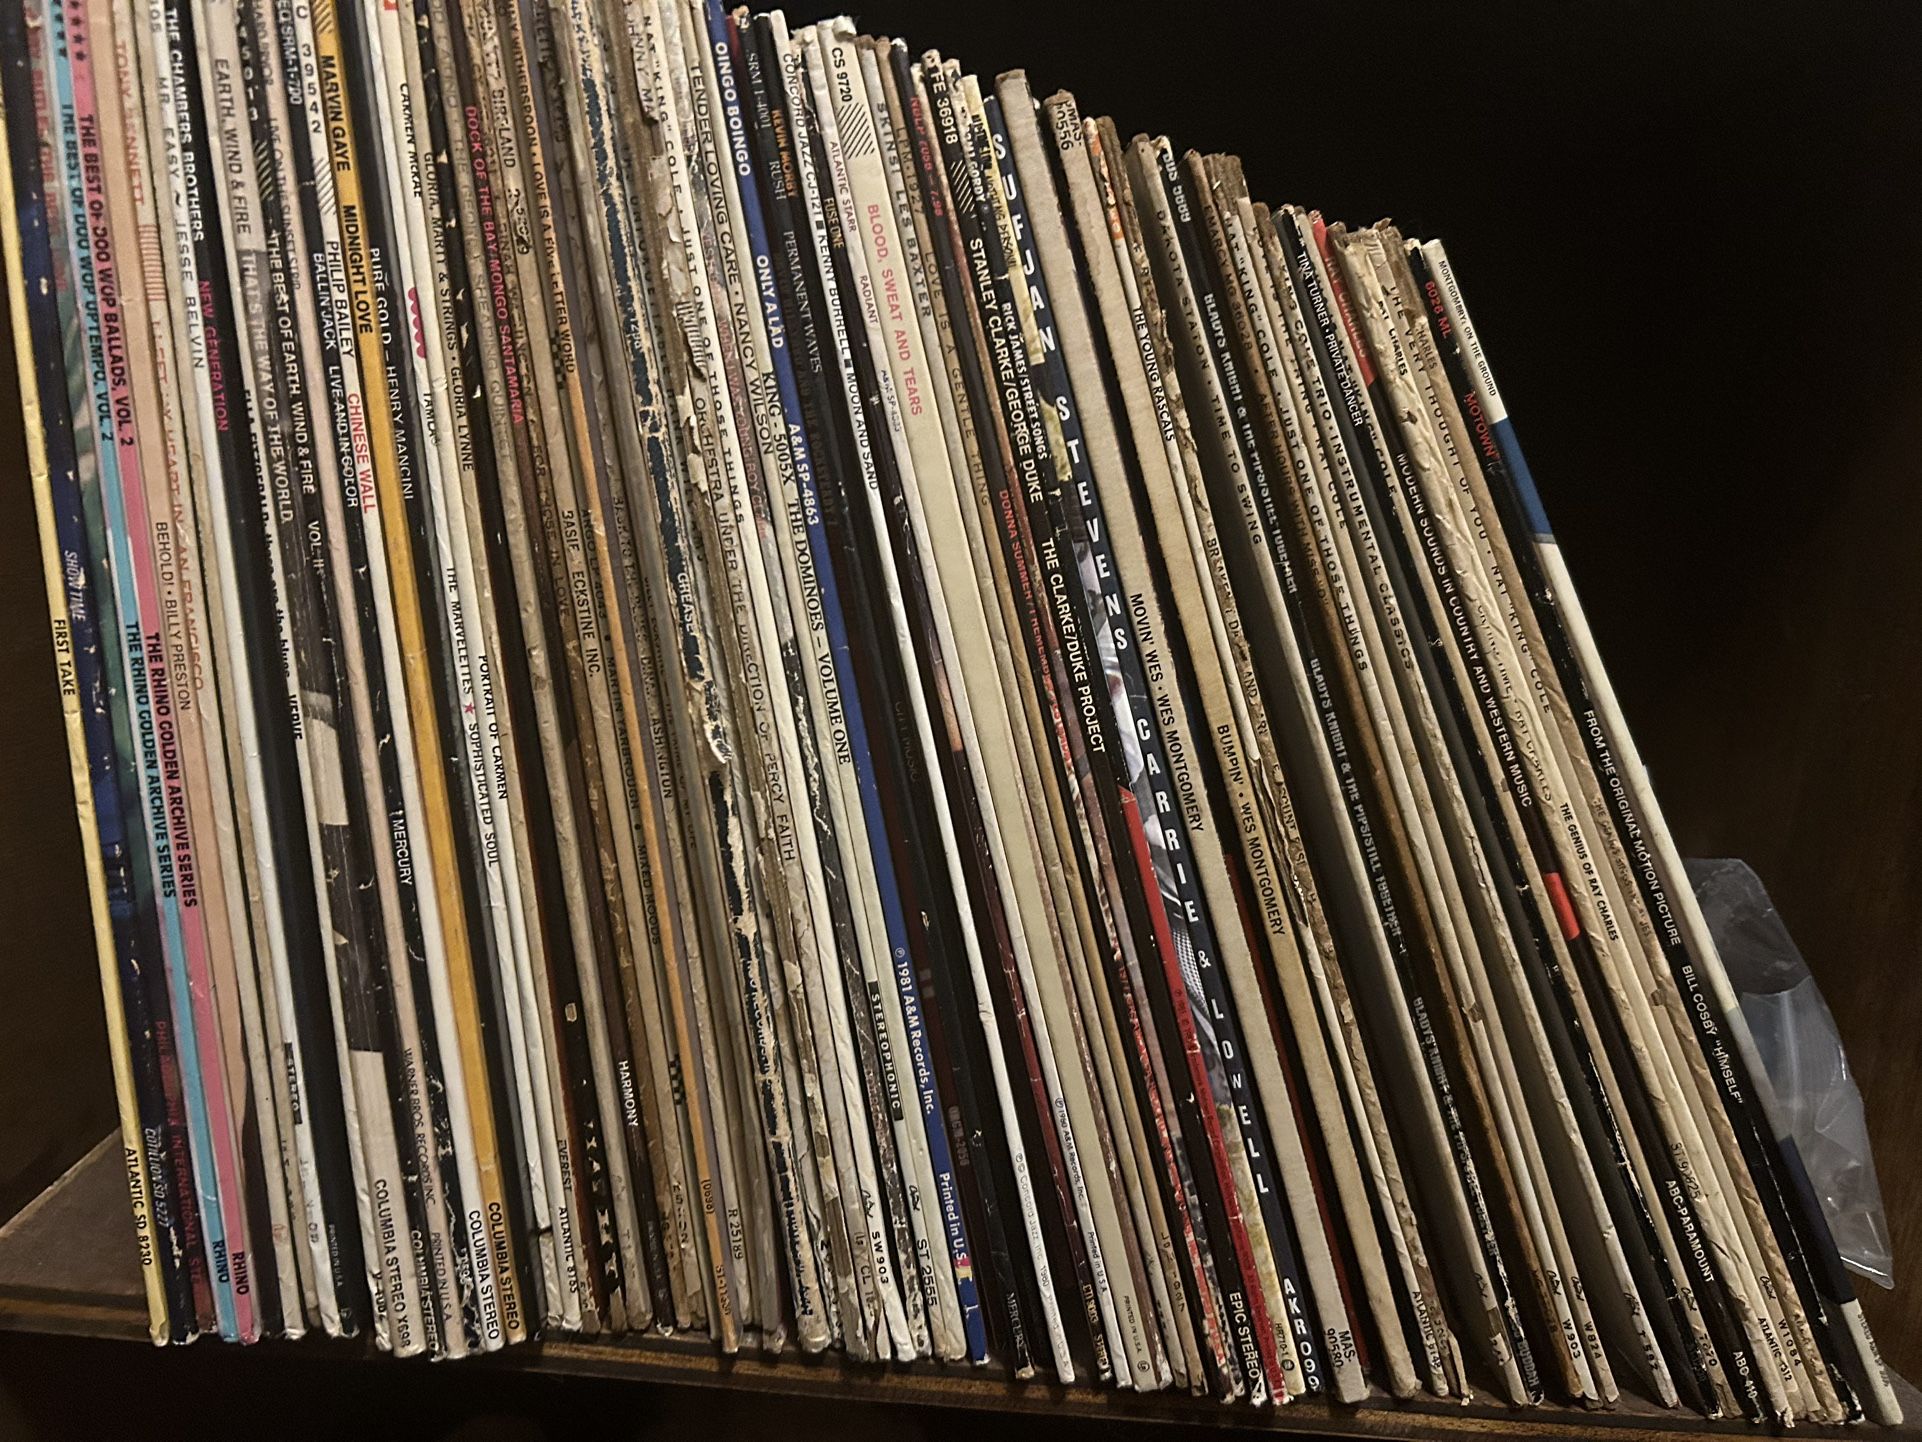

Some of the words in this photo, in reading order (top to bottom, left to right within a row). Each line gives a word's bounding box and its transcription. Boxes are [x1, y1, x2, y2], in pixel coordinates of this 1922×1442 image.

[829, 47, 846, 68] CS
[320, 54, 343, 122] MARVIN
[834, 71, 854, 102] 9720
[928, 72, 947, 93] FE
[77, 113, 97, 148] THE
[464, 106, 483, 153] DOCK
[712, 41, 738, 101] OINGO
[725, 106, 753, 176] BOINGO
[935, 98, 959, 144] 36918
[82, 152, 103, 193] BEST
[330, 127, 350, 171] GAYE
[472, 158, 487, 179] OF
[477, 186, 492, 214] THE
[766, 160, 787, 200] RUSH
[826, 141, 850, 195] ATLANTIC
[840, 197, 858, 232] STARR
[88, 199, 106, 220] OF
[865, 203, 890, 262] BLOOD,
[91, 225, 112, 262] DOO
[325, 240, 345, 293] PHILIP
[688, 62, 715, 144] TENDER
[705, 150, 731, 224] LOVING
[720, 231, 743, 283] CARE
[734, 302, 760, 369] NANCY
[748, 376, 777, 455] WILSON
[988, 133, 1058, 352] SUFJAN
[97, 267, 117, 307] WOP
[341, 205, 365, 285] MIDNIGHT
[354, 290, 372, 333] LOVE
[488, 259, 509, 319] MONGO
[753, 254, 775, 297] ONLY
[763, 302, 778, 313] A
[781, 230, 812, 318] PERMANENT
[801, 321, 824, 373] WAVES
[857, 275, 878, 323] RADIANT
[879, 269, 903, 320] SWEAT
[998, 301, 1017, 330] RICK
[1422, 280, 1445, 314] 6026
[1435, 316, 1455, 338] ML
[333, 298, 354, 358] BAILEY
[1130, 306, 1148, 332] THE
[1294, 251, 1314, 278] TINA
[1304, 279, 1330, 327] TURNER
[1322, 333, 1348, 379] PRIVATE
[1338, 380, 1364, 426] DANCER
[103, 312, 128, 391] BALLADS,
[892, 329, 912, 360] AND
[1137, 333, 1161, 382] YOUNG
[499, 325, 525, 423] SANTAMARIA
[843, 372, 864, 415] MOON
[901, 366, 924, 415] TEARS
[966, 237, 998, 310] STANLEY
[985, 315, 1033, 454] CLARKE/GEORGE
[1020, 460, 1045, 502] DUKE
[1006, 333, 1040, 418] JAMES/STREET
[114, 398, 133, 432] VOL.
[758, 372, 781, 416] KING
[1151, 386, 1177, 441] RASCALS
[119, 435, 135, 446] 2
[345, 393, 368, 463] CHINESE
[785, 423, 806, 460] A&M
[854, 419, 871, 447] AND
[1029, 422, 1050, 460] SONGS
[770, 434, 795, 486] 5005X
[861, 451, 881, 490] SAND
[1394, 453, 1427, 513] MODERN
[356, 468, 375, 513] WALL
[794, 463, 821, 525] SP-4863
[784, 498, 806, 536] THE
[1053, 395, 1130, 649] STEVENS
[153, 521, 176, 586] BEHOLD!
[1039, 537, 1061, 570] THE
[1418, 518, 1449, 575] SOUNDS
[674, 572, 698, 632] GREASE
[792, 539, 825, 631] DOMINOES
[1439, 578, 1456, 593] IN
[53, 618, 69, 653] FIRST
[164, 599, 183, 640] BILLY
[1048, 573, 1089, 682] CLARKE/DUKE
[1127, 593, 1156, 647] MOVIN'
[1446, 597, 1480, 660] COUNTRY
[145, 631, 163, 664] THE
[1142, 649, 1165, 682] WES
[58, 660, 75, 695] TAKE
[150, 667, 171, 716] RHINO
[170, 643, 192, 710] PRESTON
[815, 653, 844, 724] VOLUME
[1471, 665, 1492, 694] AND
[448, 599, 473, 694] MARVELETTES
[466, 722, 493, 824] SOPHISTICATED
[483, 833, 500, 867] SOUL
[1076, 685, 1107, 752] PROJECT
[1155, 694, 1177, 725] WES
[1483, 697, 1517, 761] WESTERN
[157, 720, 179, 779] GOLDEN
[831, 729, 852, 764] ONE
[1215, 724, 1244, 784] BUMPIN'
[1164, 730, 1206, 832] MONTGOMERY
[1507, 764, 1534, 807] MUSIC
[166, 784, 189, 850] ARCHIVE
[1132, 718, 1200, 922] CARRIE
[1236, 803, 1258, 835] WES
[1557, 802, 1575, 821] THE
[1581, 710, 1607, 748] FROM
[1596, 749, 1618, 776] THE
[1607, 778, 1641, 837] ORIGINAL
[1630, 840, 1661, 890] MOTION
[1650, 892, 1682, 945] PICTURE
[1564, 823, 1589, 860] GENIUS
[176, 854, 197, 907] SERIES
[1245, 836, 1286, 935] MONTGOMERY
[1579, 862, 1595, 875] OF
[1585, 878, 1604, 898] RAY
[1594, 900, 1620, 940] CHARLES
[894, 961, 913, 991] 1981
[1195, 950, 1213, 968] &
[901, 995, 921, 1027] A&M
[1678, 965, 1700, 991] BILL
[1689, 993, 1717, 1035] COSBY
[868, 993, 902, 1109] STEREOPHONIC
[908, 1029, 932, 1085] Records,
[615, 1059, 639, 1127] HARMONY
[921, 1089, 938, 1114] Inc.
[1208, 998, 1269, 1193] LOWELL
[124, 1147, 144, 1208] ATLANTIC
[936, 1172, 960, 1220] Printed
[133, 1213, 147, 1230] SD
[373, 1179, 397, 1253] COLUMBIA
[385, 1256, 406, 1312] STEREO
[947, 1223, 963, 1235] in
[1664, 1180, 1714, 1282] ABC-PARAMOUNT
[136, 1235, 152, 1265] 8230
[212, 1239, 229, 1283] RHINO
[231, 1251, 249, 1295] RHINO
[487, 1201, 510, 1274] COLUMBIA
[499, 1277, 520, 1329] STEREO
[914, 1238, 930, 1260] ST
[467, 1209, 491, 1282] COLUMBIA
[479, 1286, 500, 1340] STEREO
[919, 1265, 940, 1306] 2555
[1227, 1291, 1248, 1323] EPIC
[1236, 1327, 1262, 1378] STEREO
[1280, 1277, 1322, 1391] AKR099
[1756, 1317, 1783, 1358] ATLANTIC
